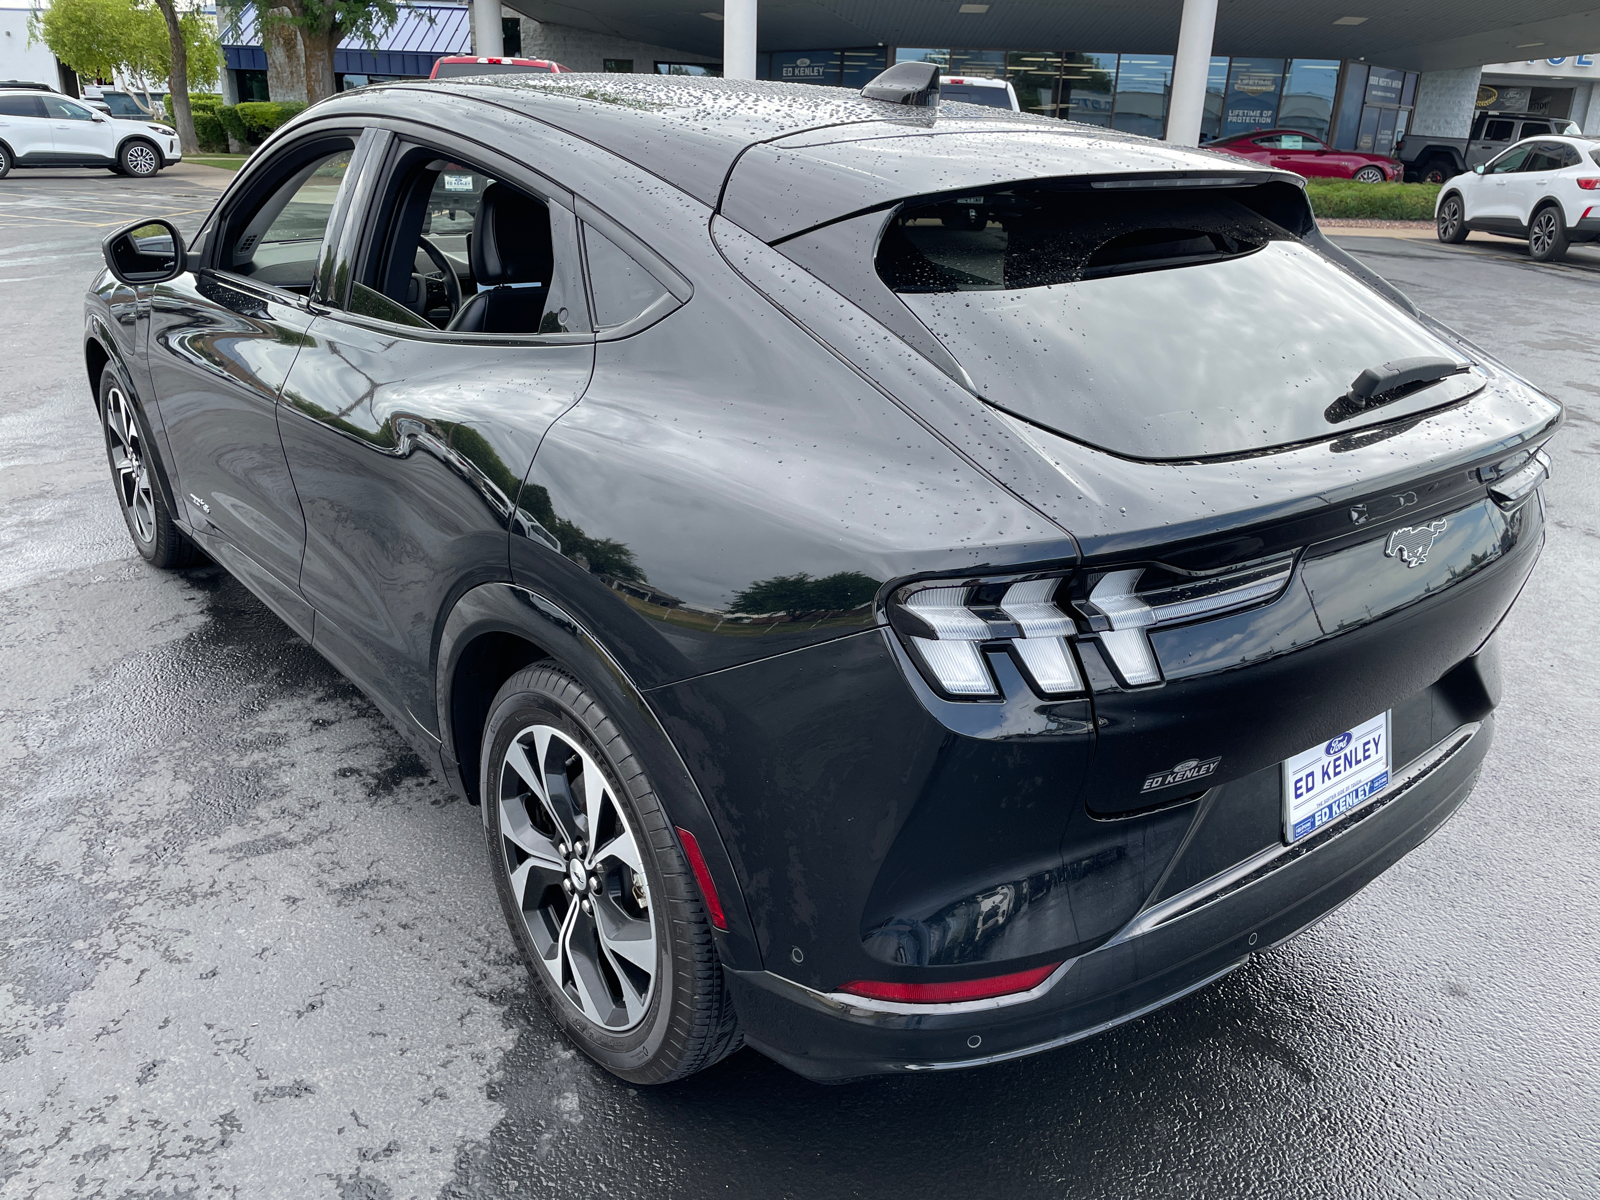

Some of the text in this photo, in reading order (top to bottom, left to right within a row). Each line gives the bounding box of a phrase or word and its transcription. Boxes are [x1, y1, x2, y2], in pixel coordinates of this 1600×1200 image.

[782, 66, 824, 77] ED KENLEY
[1228, 109, 1261, 117] LIFETIME
[1329, 735, 1348, 754] Ford
[1142, 761, 1219, 790] ED KENLEY
[1293, 734, 1382, 800] ED KENLEY
[1314, 807, 1330, 827] ED
[1332, 782, 1372, 819] KENLEY
